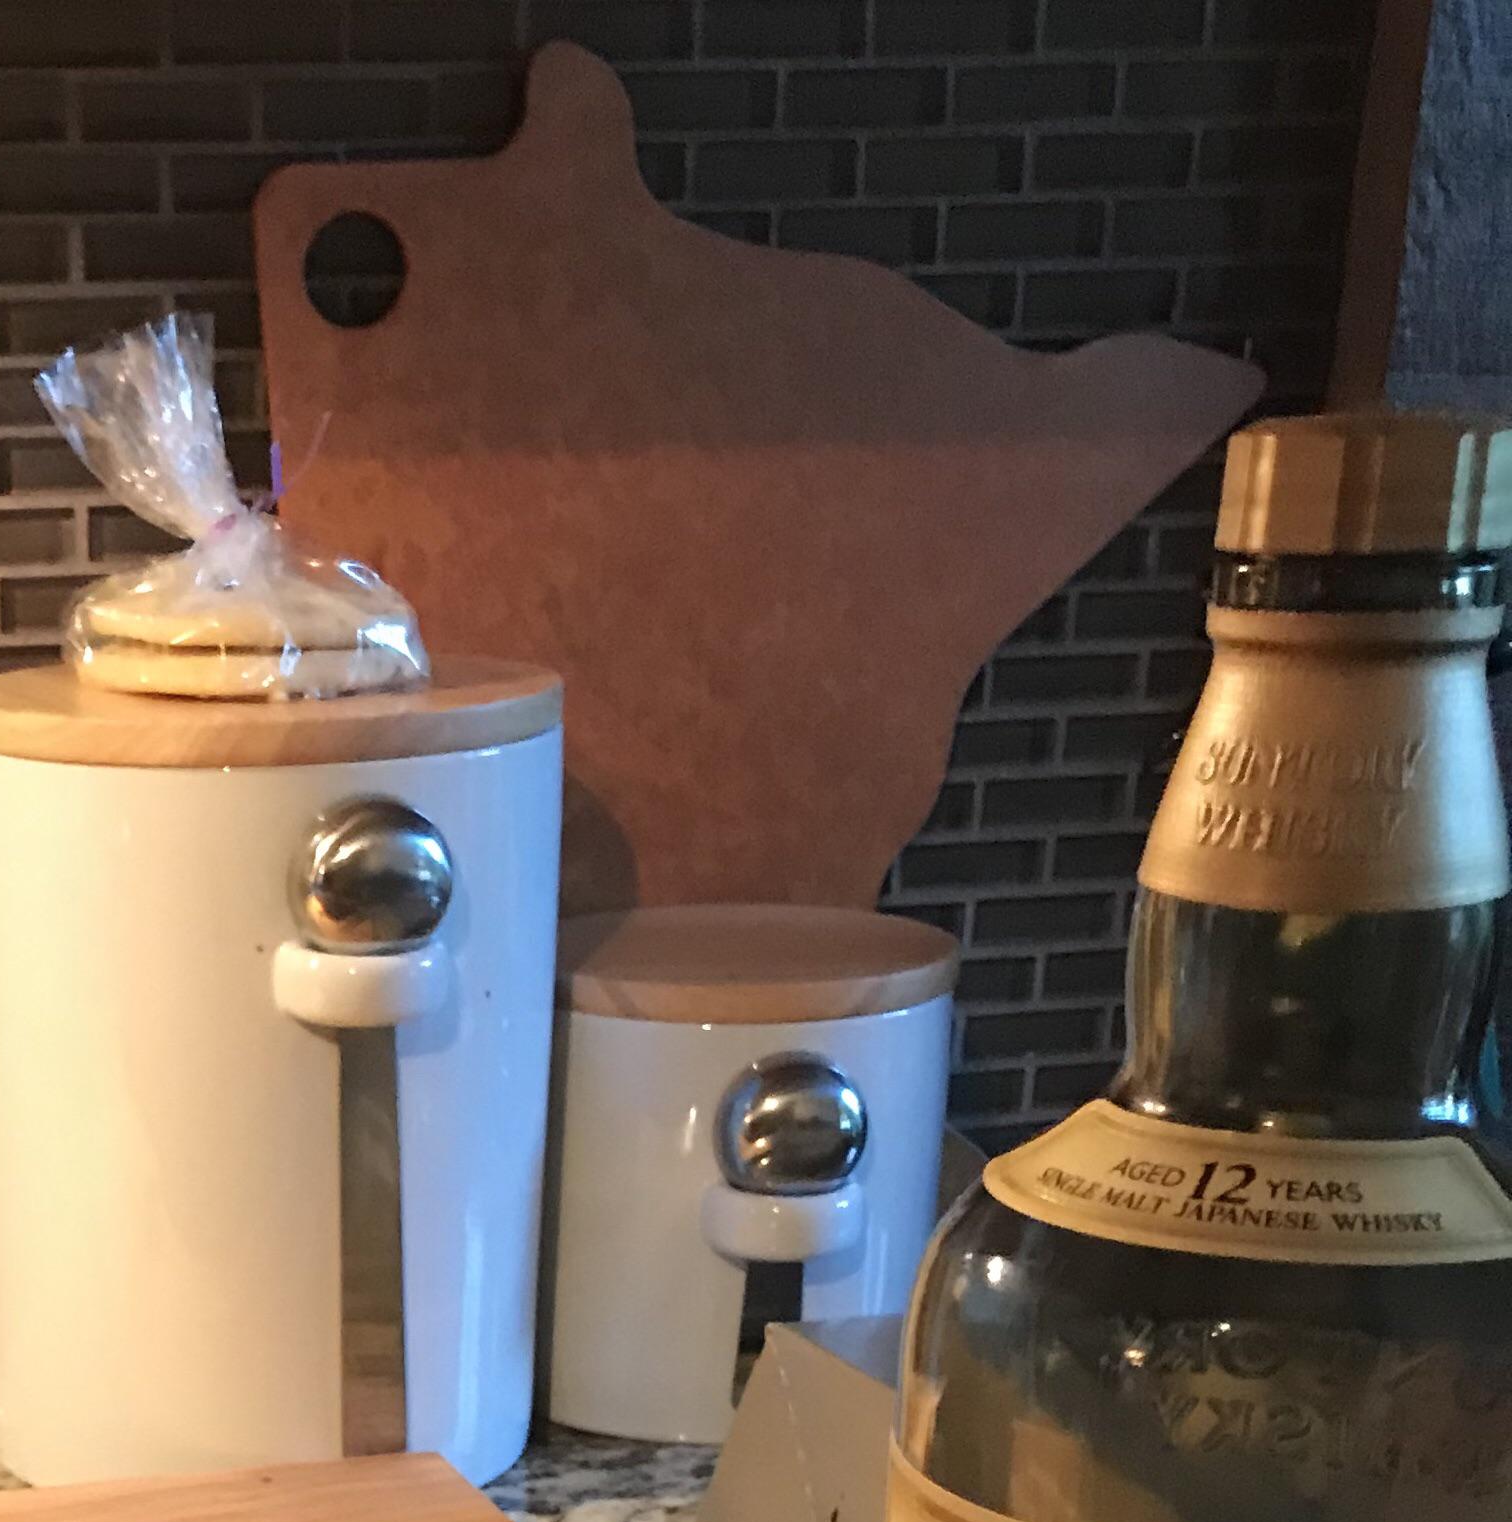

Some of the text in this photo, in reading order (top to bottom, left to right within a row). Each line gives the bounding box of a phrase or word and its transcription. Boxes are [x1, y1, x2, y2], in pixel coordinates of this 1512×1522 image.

[1037, 1167, 1444, 1232] SINGLE MALT JAPANESE WHISKY
[1110, 1158, 1364, 1204] AGED 12 YEARS
